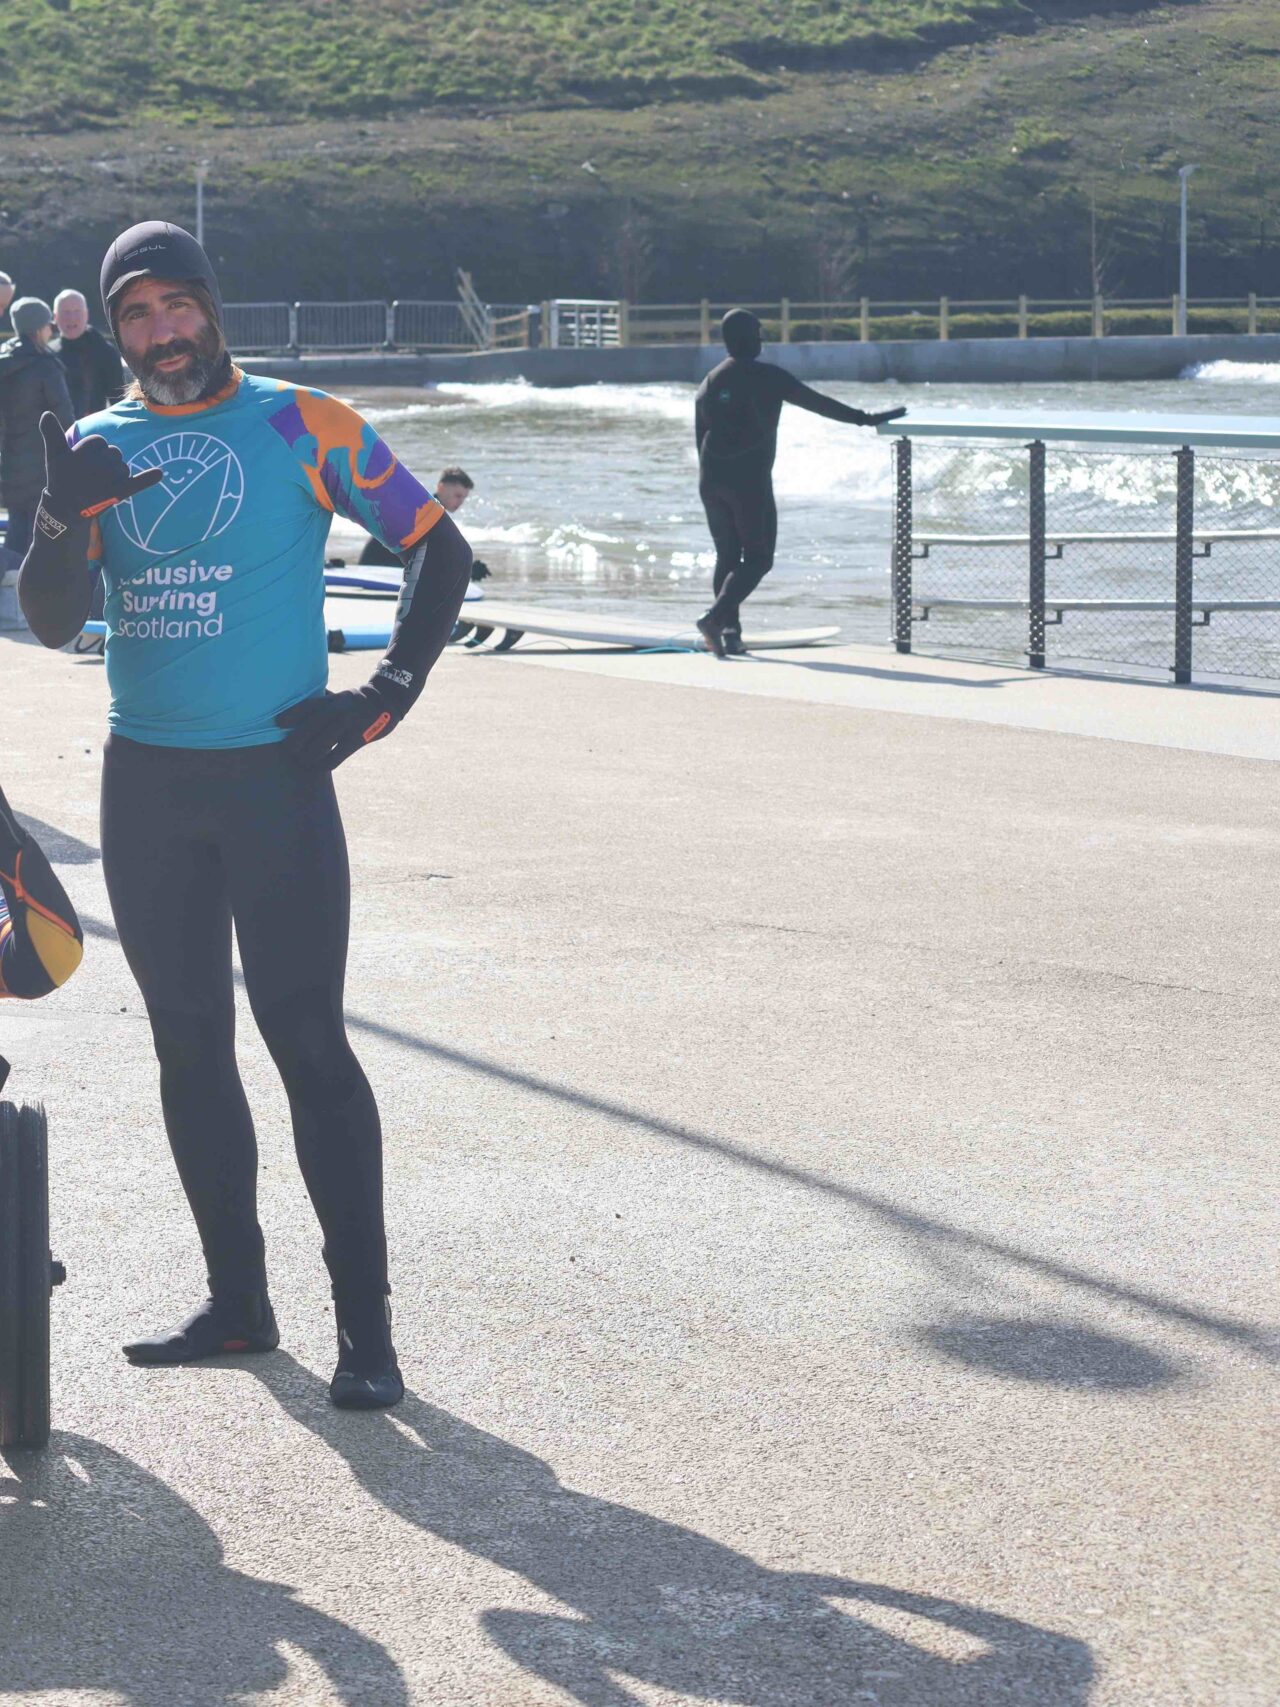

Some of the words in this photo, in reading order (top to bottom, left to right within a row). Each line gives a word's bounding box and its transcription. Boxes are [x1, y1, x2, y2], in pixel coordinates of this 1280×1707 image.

[118, 559, 233, 589] lusive
[122, 589, 217, 616] Surfing
[115, 612, 223, 638] Scotland
